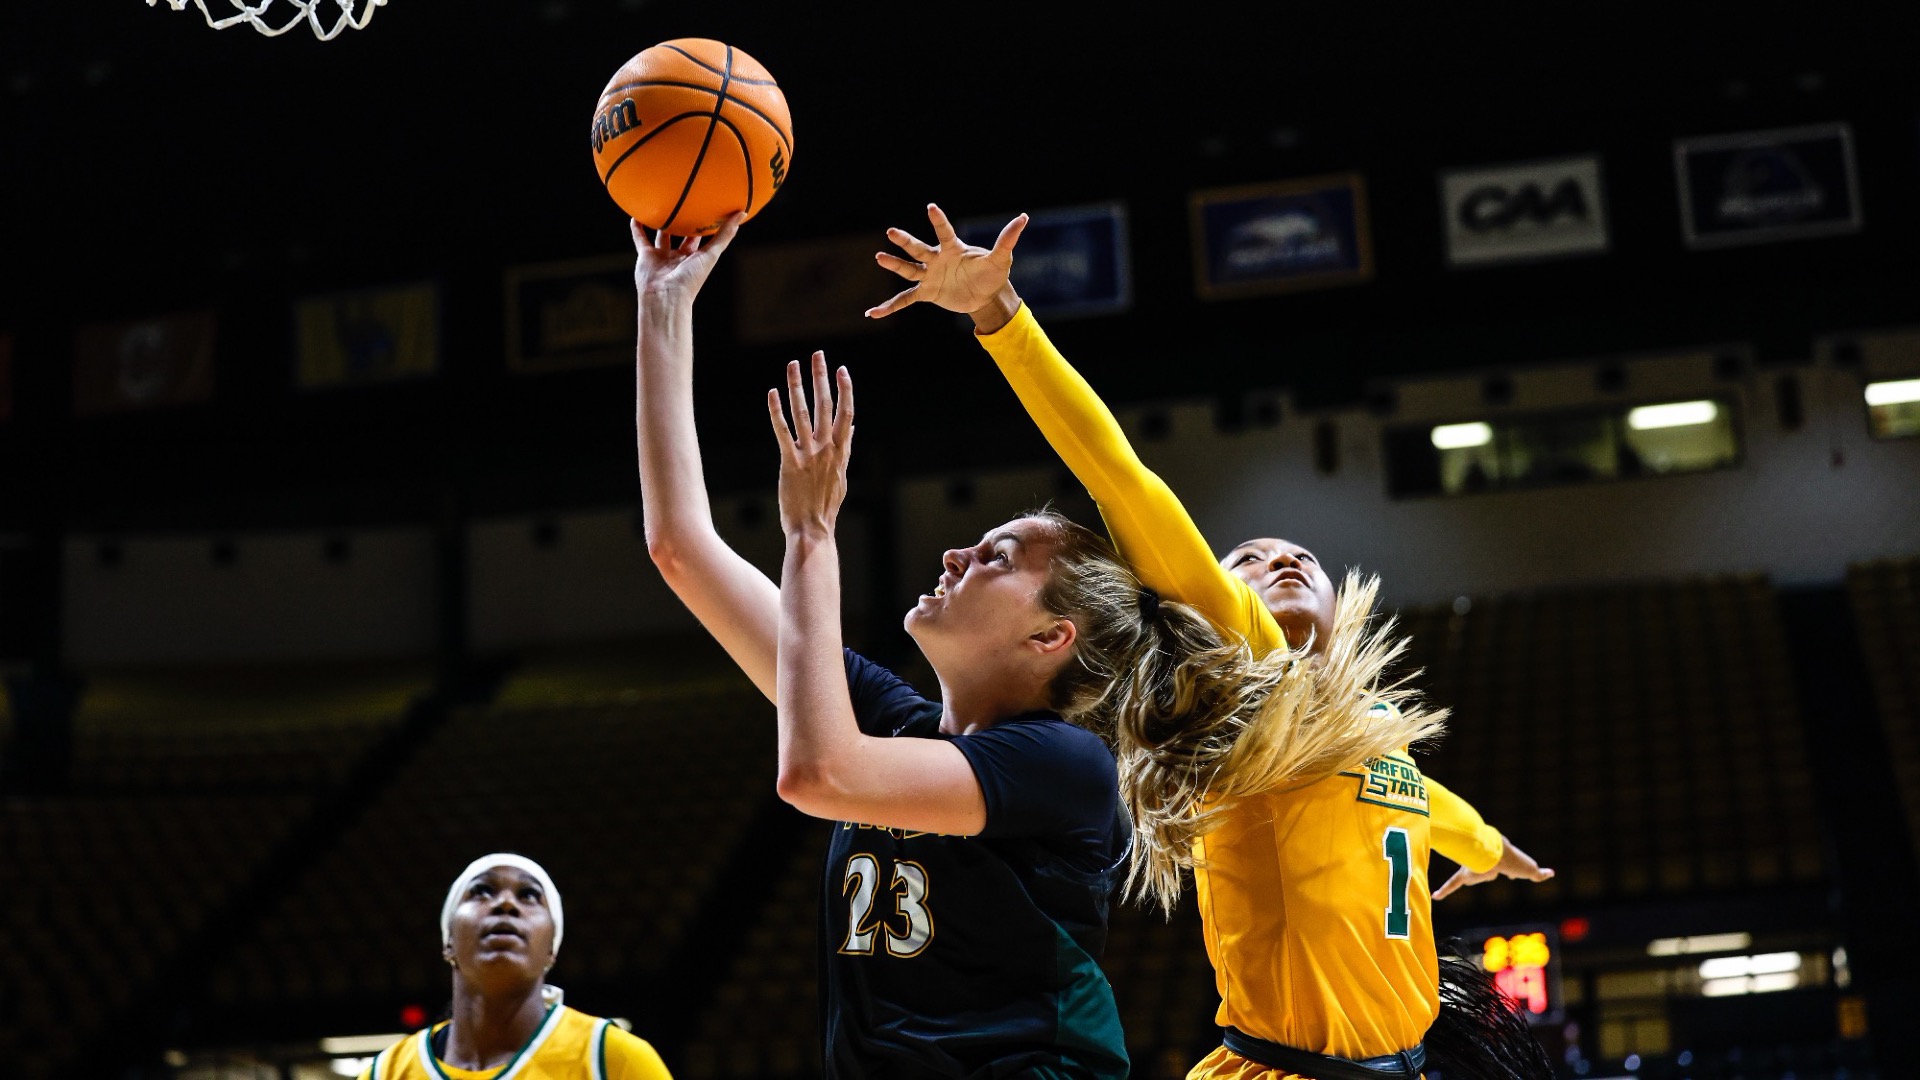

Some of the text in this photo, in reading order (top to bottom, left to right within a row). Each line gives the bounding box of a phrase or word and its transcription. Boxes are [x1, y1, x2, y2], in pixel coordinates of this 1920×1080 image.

[1366, 773, 1426, 801] STATE
[837, 853, 934, 959] 23
[1382, 826, 1412, 940] 1
